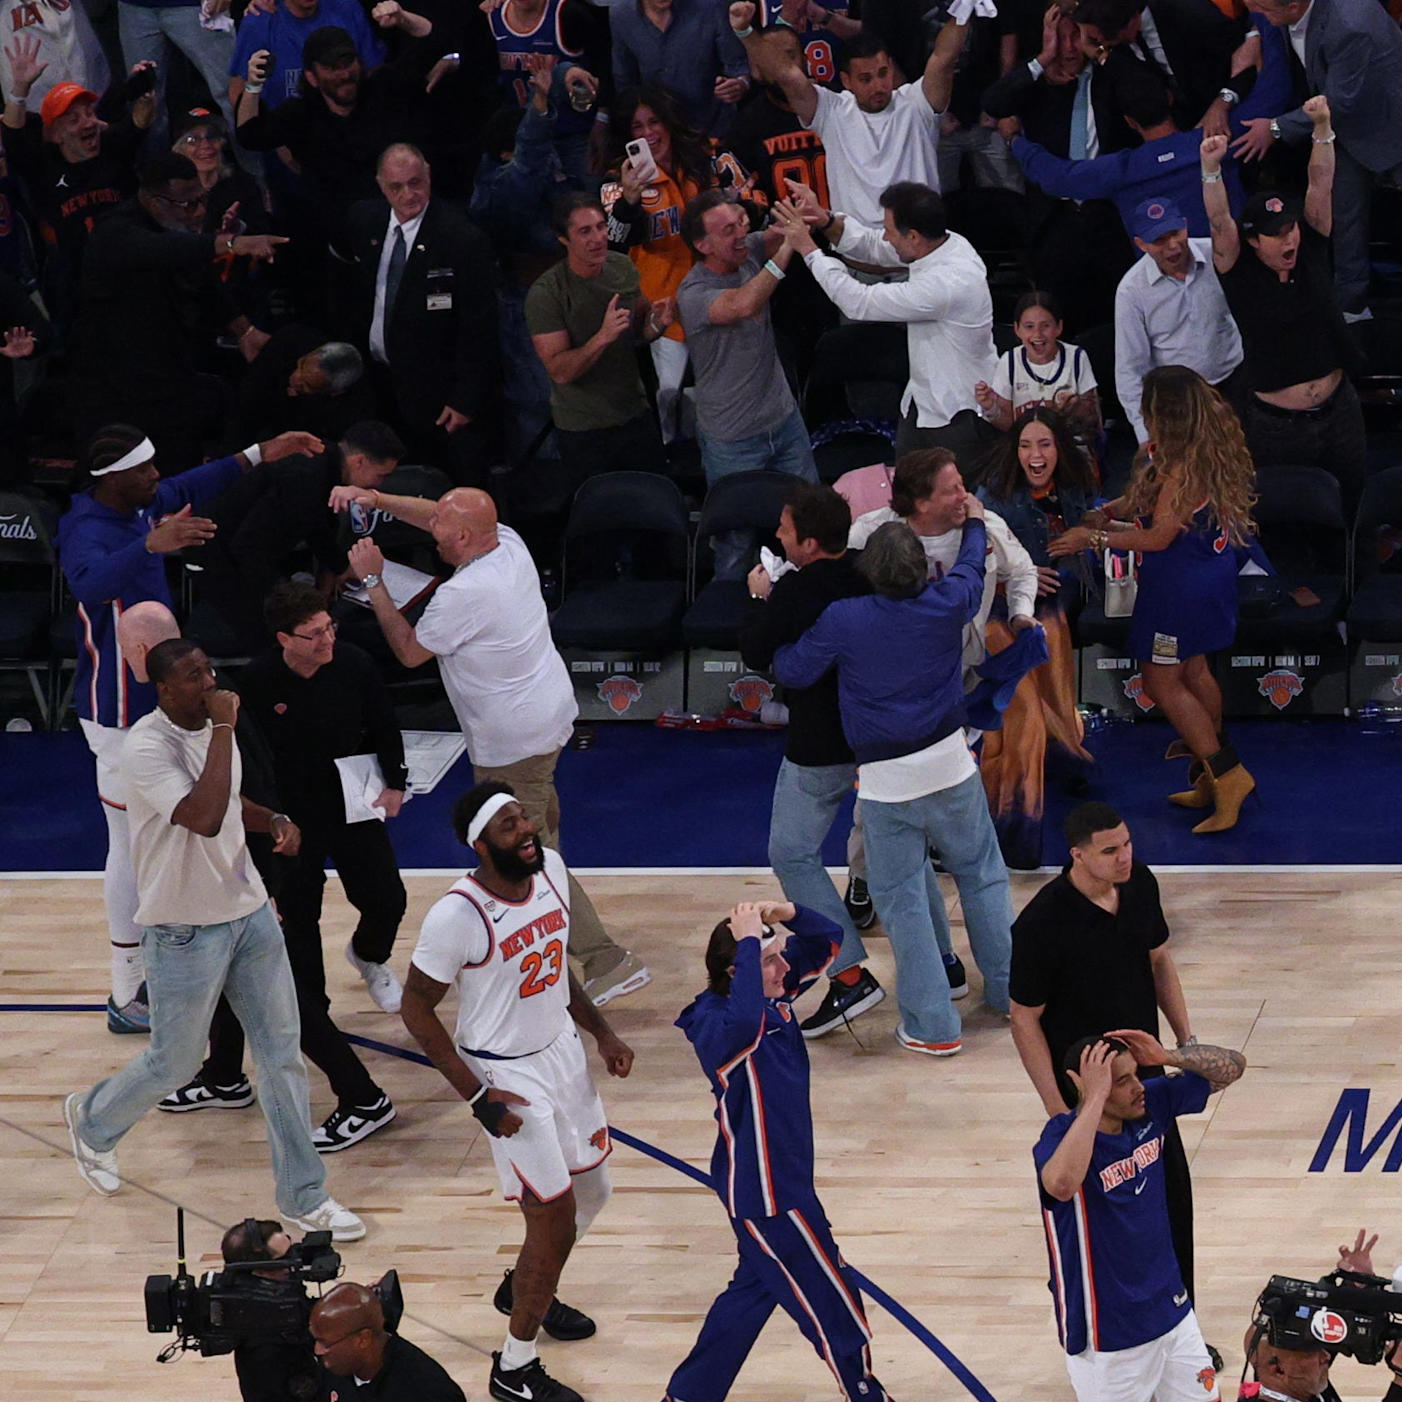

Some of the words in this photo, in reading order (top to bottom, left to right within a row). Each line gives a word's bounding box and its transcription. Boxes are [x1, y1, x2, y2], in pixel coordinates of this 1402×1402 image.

[763, 130, 822, 156] VUITT
[650, 204, 681, 240] EW
[0, 513, 38, 541] nals
[499, 925, 534, 963] NEW
[531, 909, 567, 939] YORK
[519, 938, 563, 1000] 23
[1100, 1156, 1136, 1193] NEW
